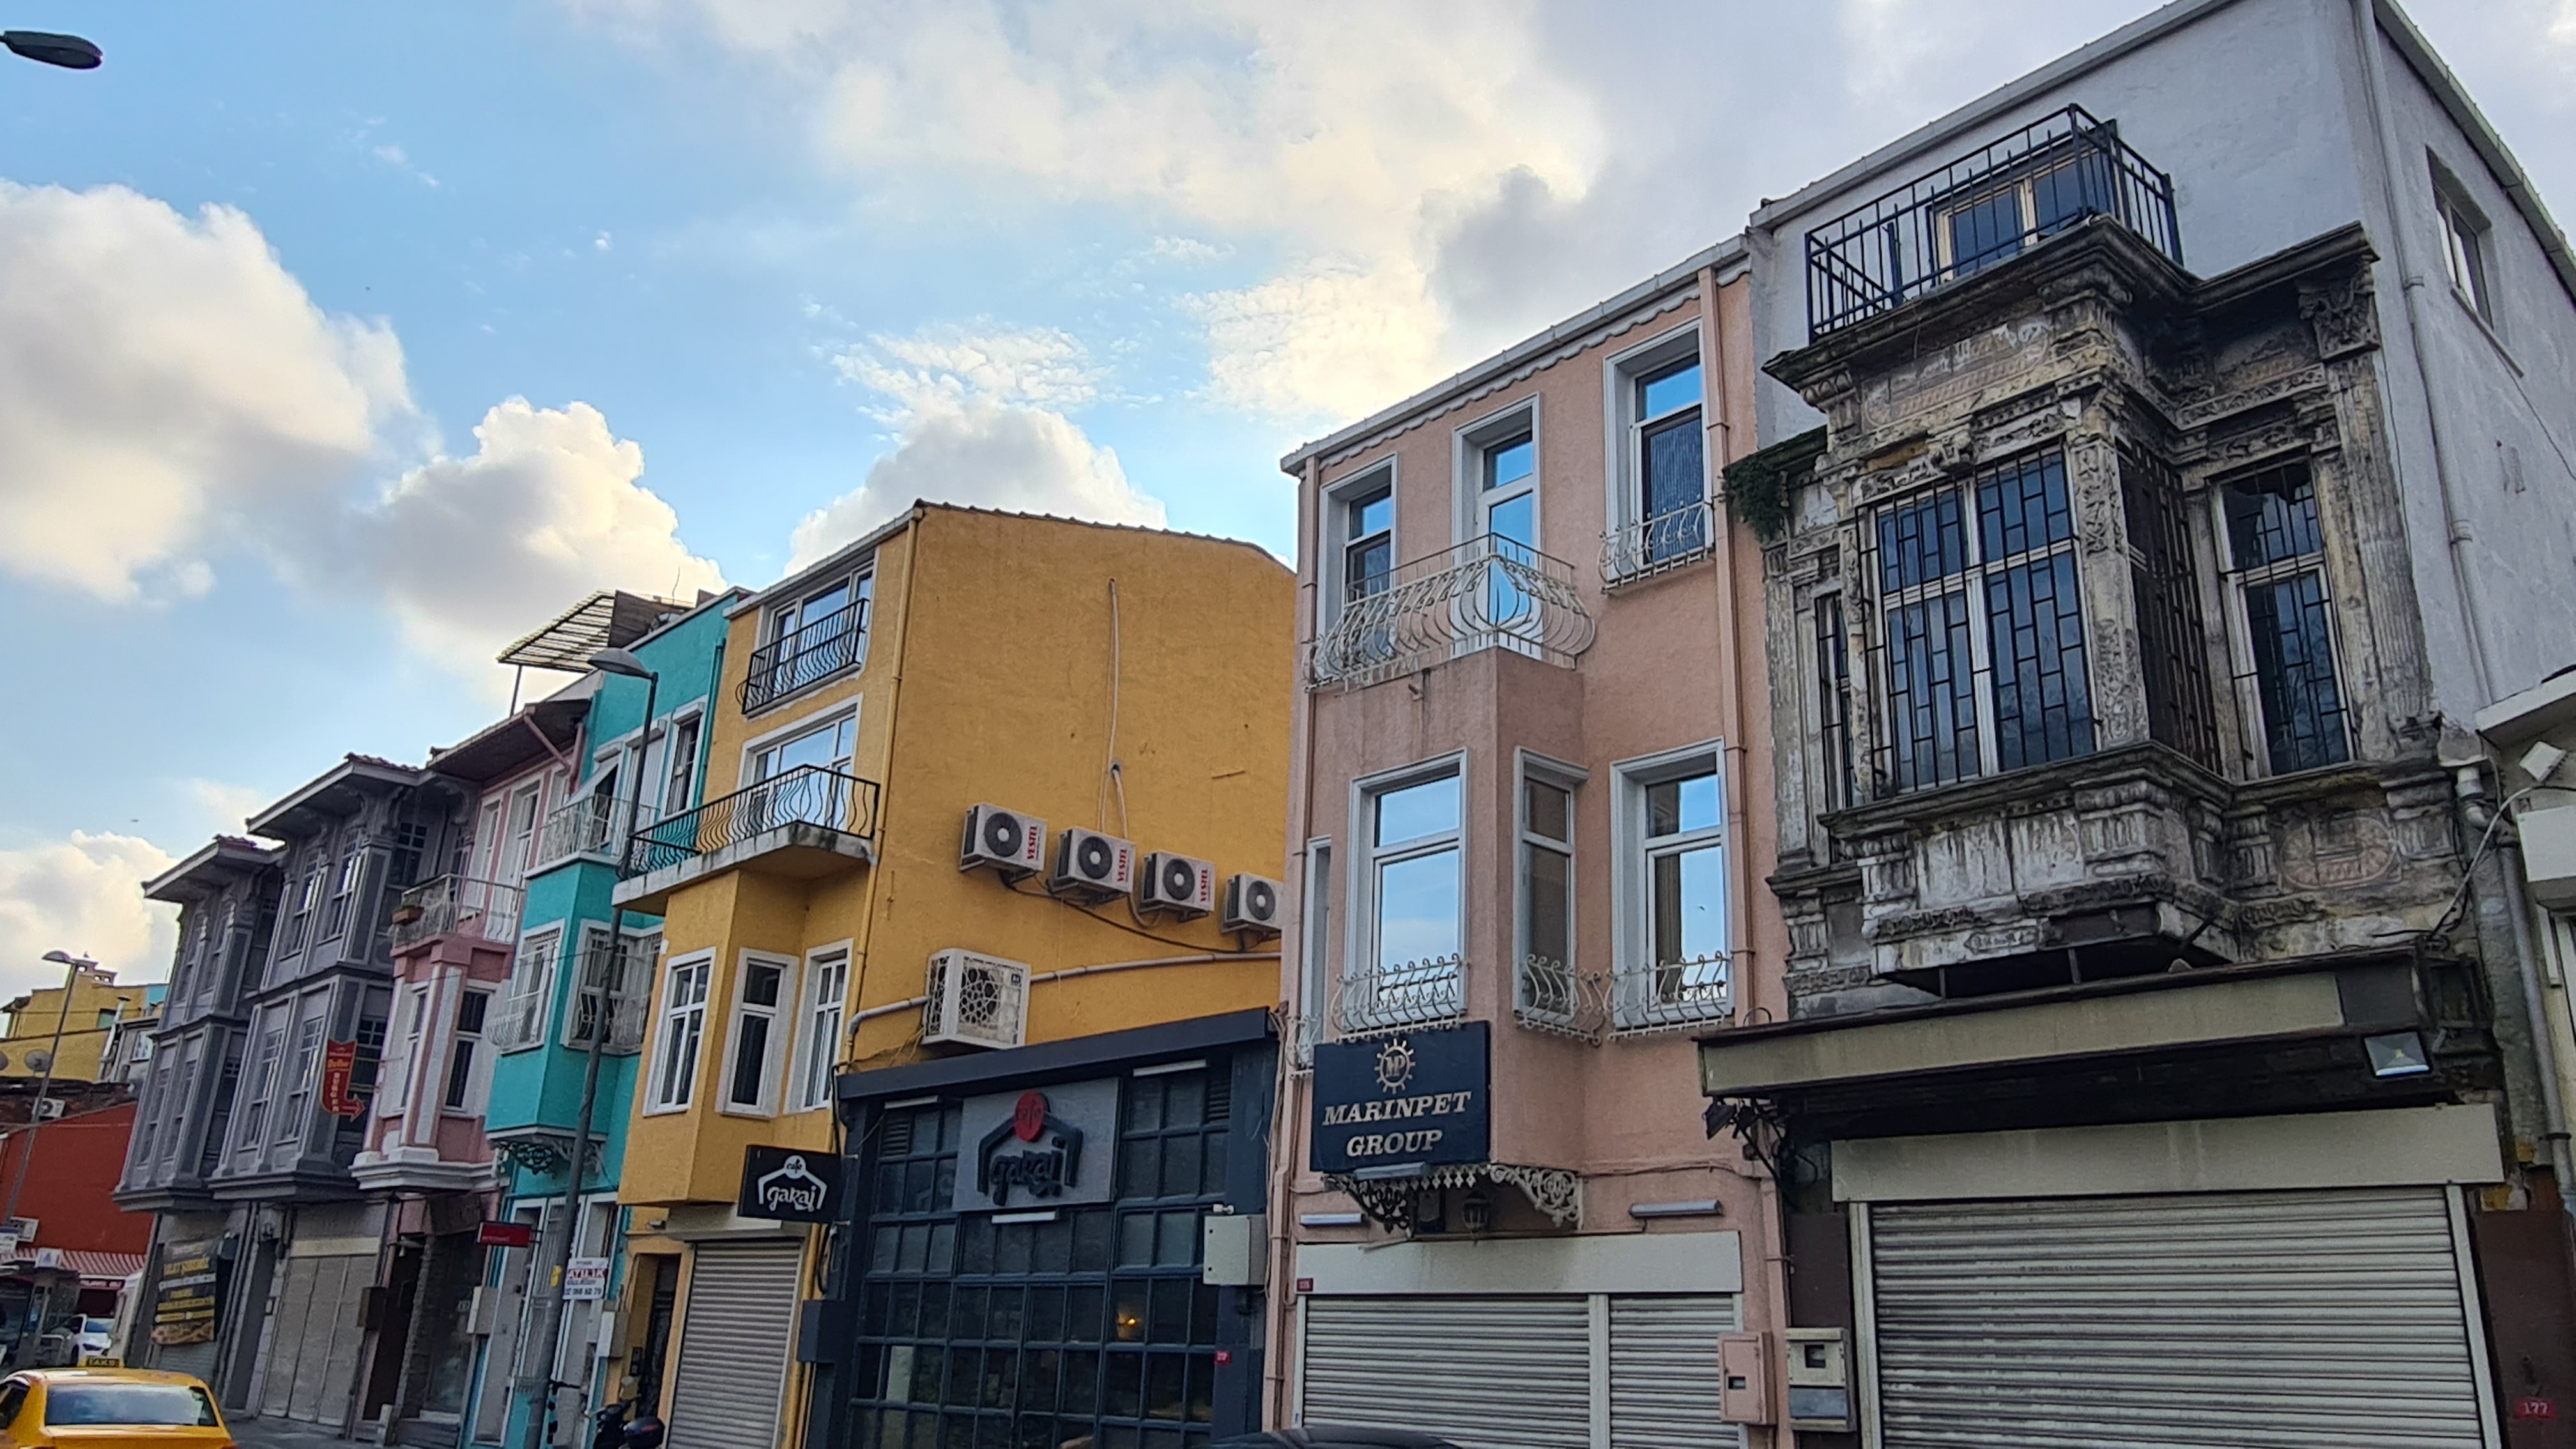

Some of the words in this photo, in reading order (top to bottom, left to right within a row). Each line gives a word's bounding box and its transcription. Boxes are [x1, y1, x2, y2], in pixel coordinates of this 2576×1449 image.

[1027, 825, 1038, 859] VESTEL
[1117, 849, 1127, 882] VESTEL
[1322, 1091, 1472, 1126] MARINPET
[1346, 1130, 1443, 1157] GROUP
[2524, 1401, 2548, 1415] 177
